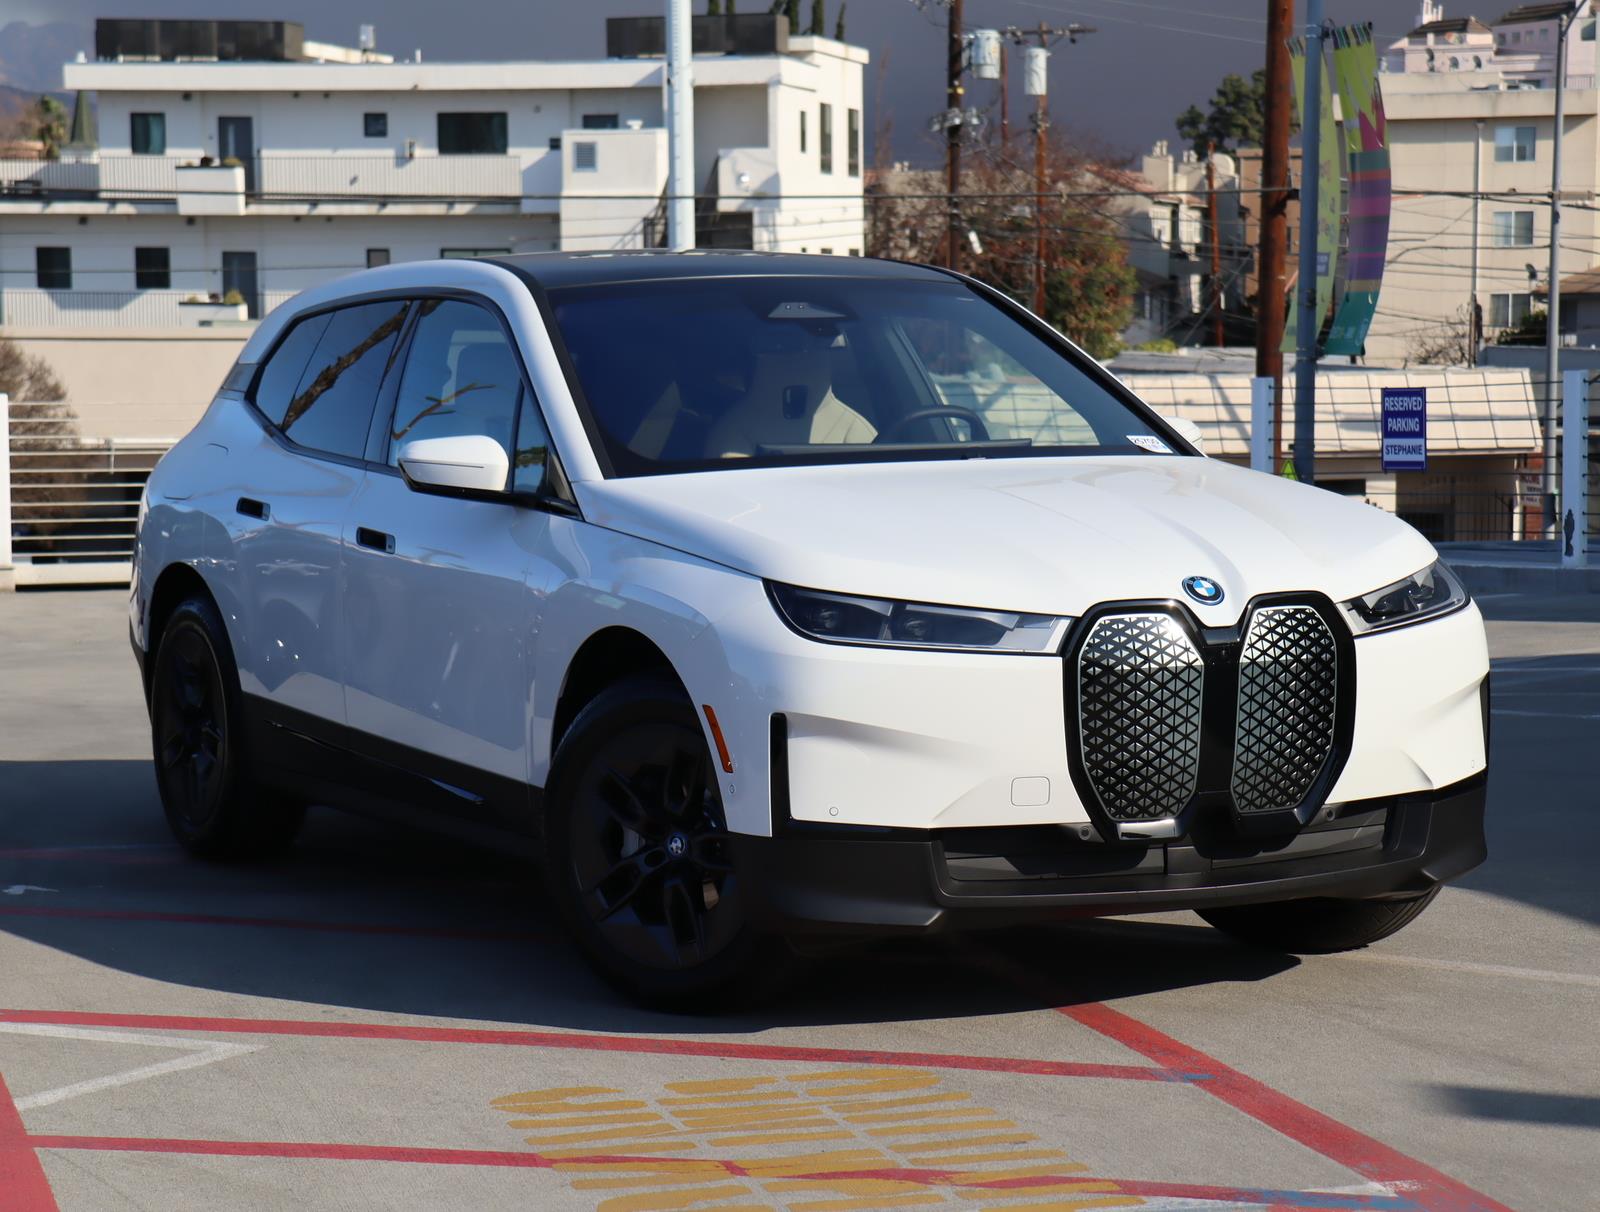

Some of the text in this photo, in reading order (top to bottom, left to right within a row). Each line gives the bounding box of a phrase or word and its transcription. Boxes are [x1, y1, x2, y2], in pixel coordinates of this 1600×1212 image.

[1385, 397, 1423, 411] RESERVED
[1388, 418, 1420, 432] PARKING
[1385, 445, 1423, 456] STEPHANIE
